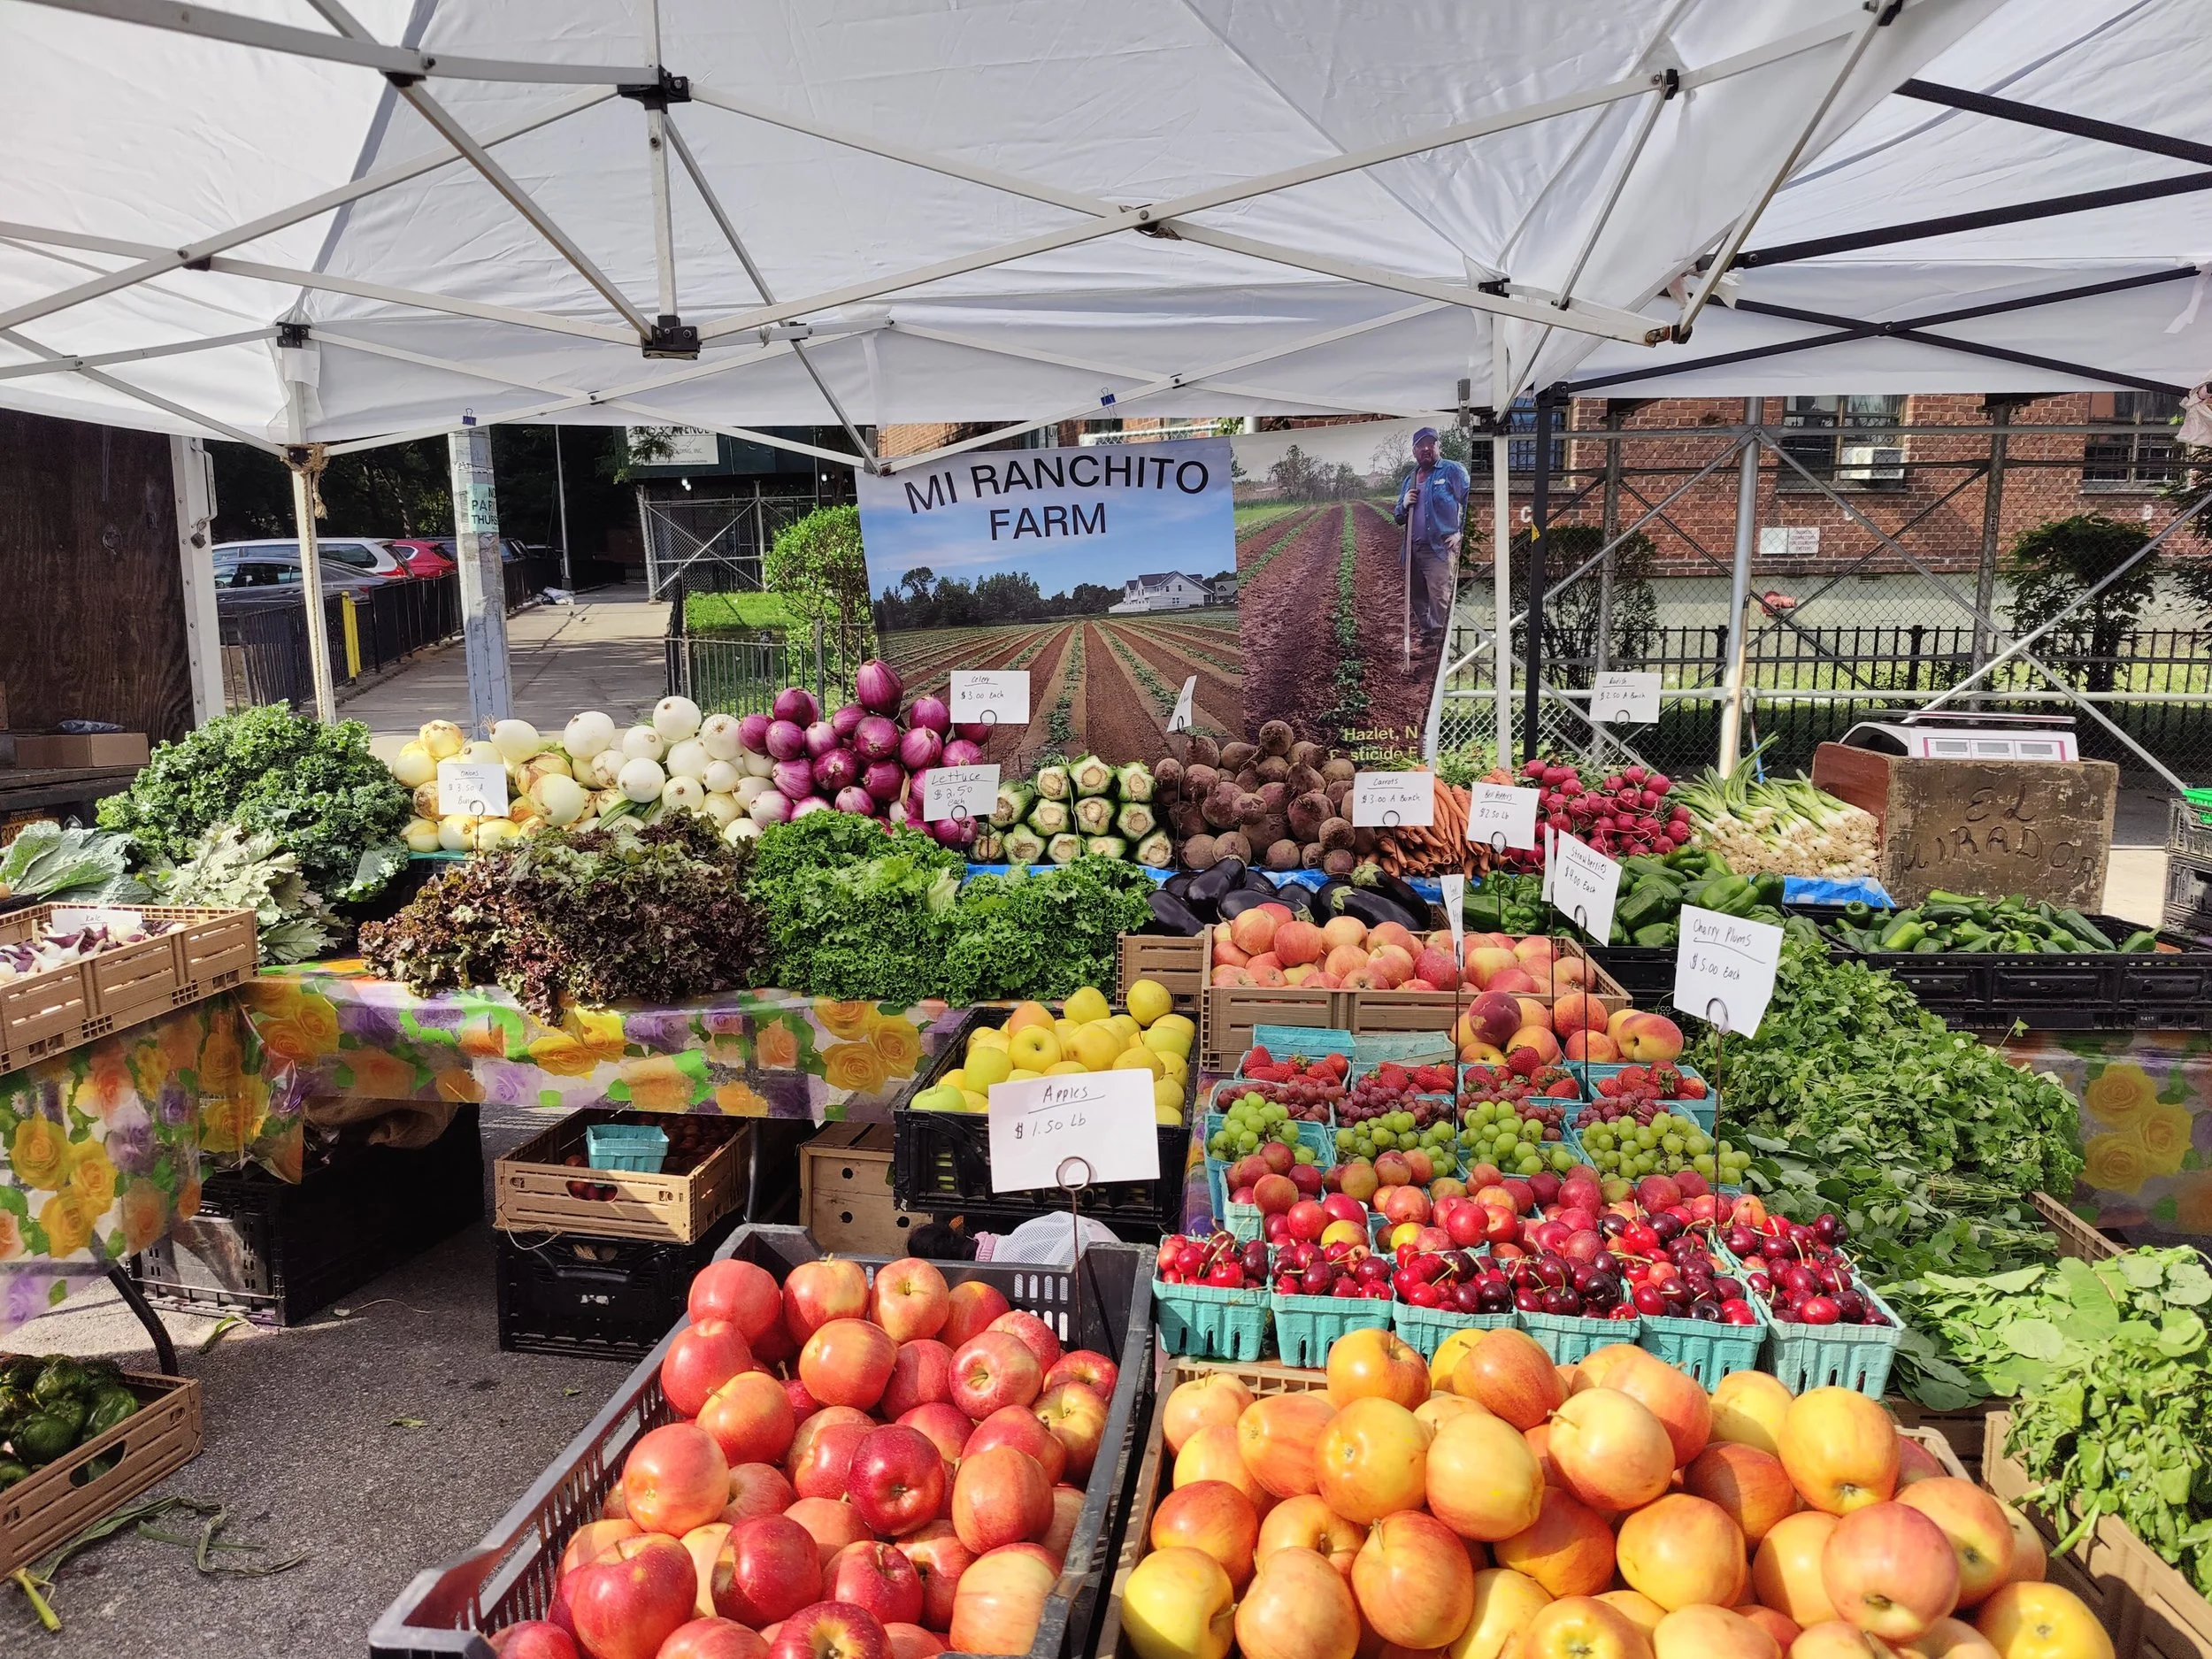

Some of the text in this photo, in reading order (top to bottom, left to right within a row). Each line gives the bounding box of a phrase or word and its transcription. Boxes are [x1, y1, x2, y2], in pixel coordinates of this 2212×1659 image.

[904, 455, 1210, 514] MI RANCHITO
[989, 502, 1107, 541] FARM
[1344, 726, 1400, 741] Hazlet,
[931, 770, 981, 785] Lettuce
[1963, 784, 2038, 822] EL
[1694, 918, 1753, 948] Cherry Plums
[1042, 1085, 1088, 1104] Apples
[1071, 1112, 1087, 1127] Lb
